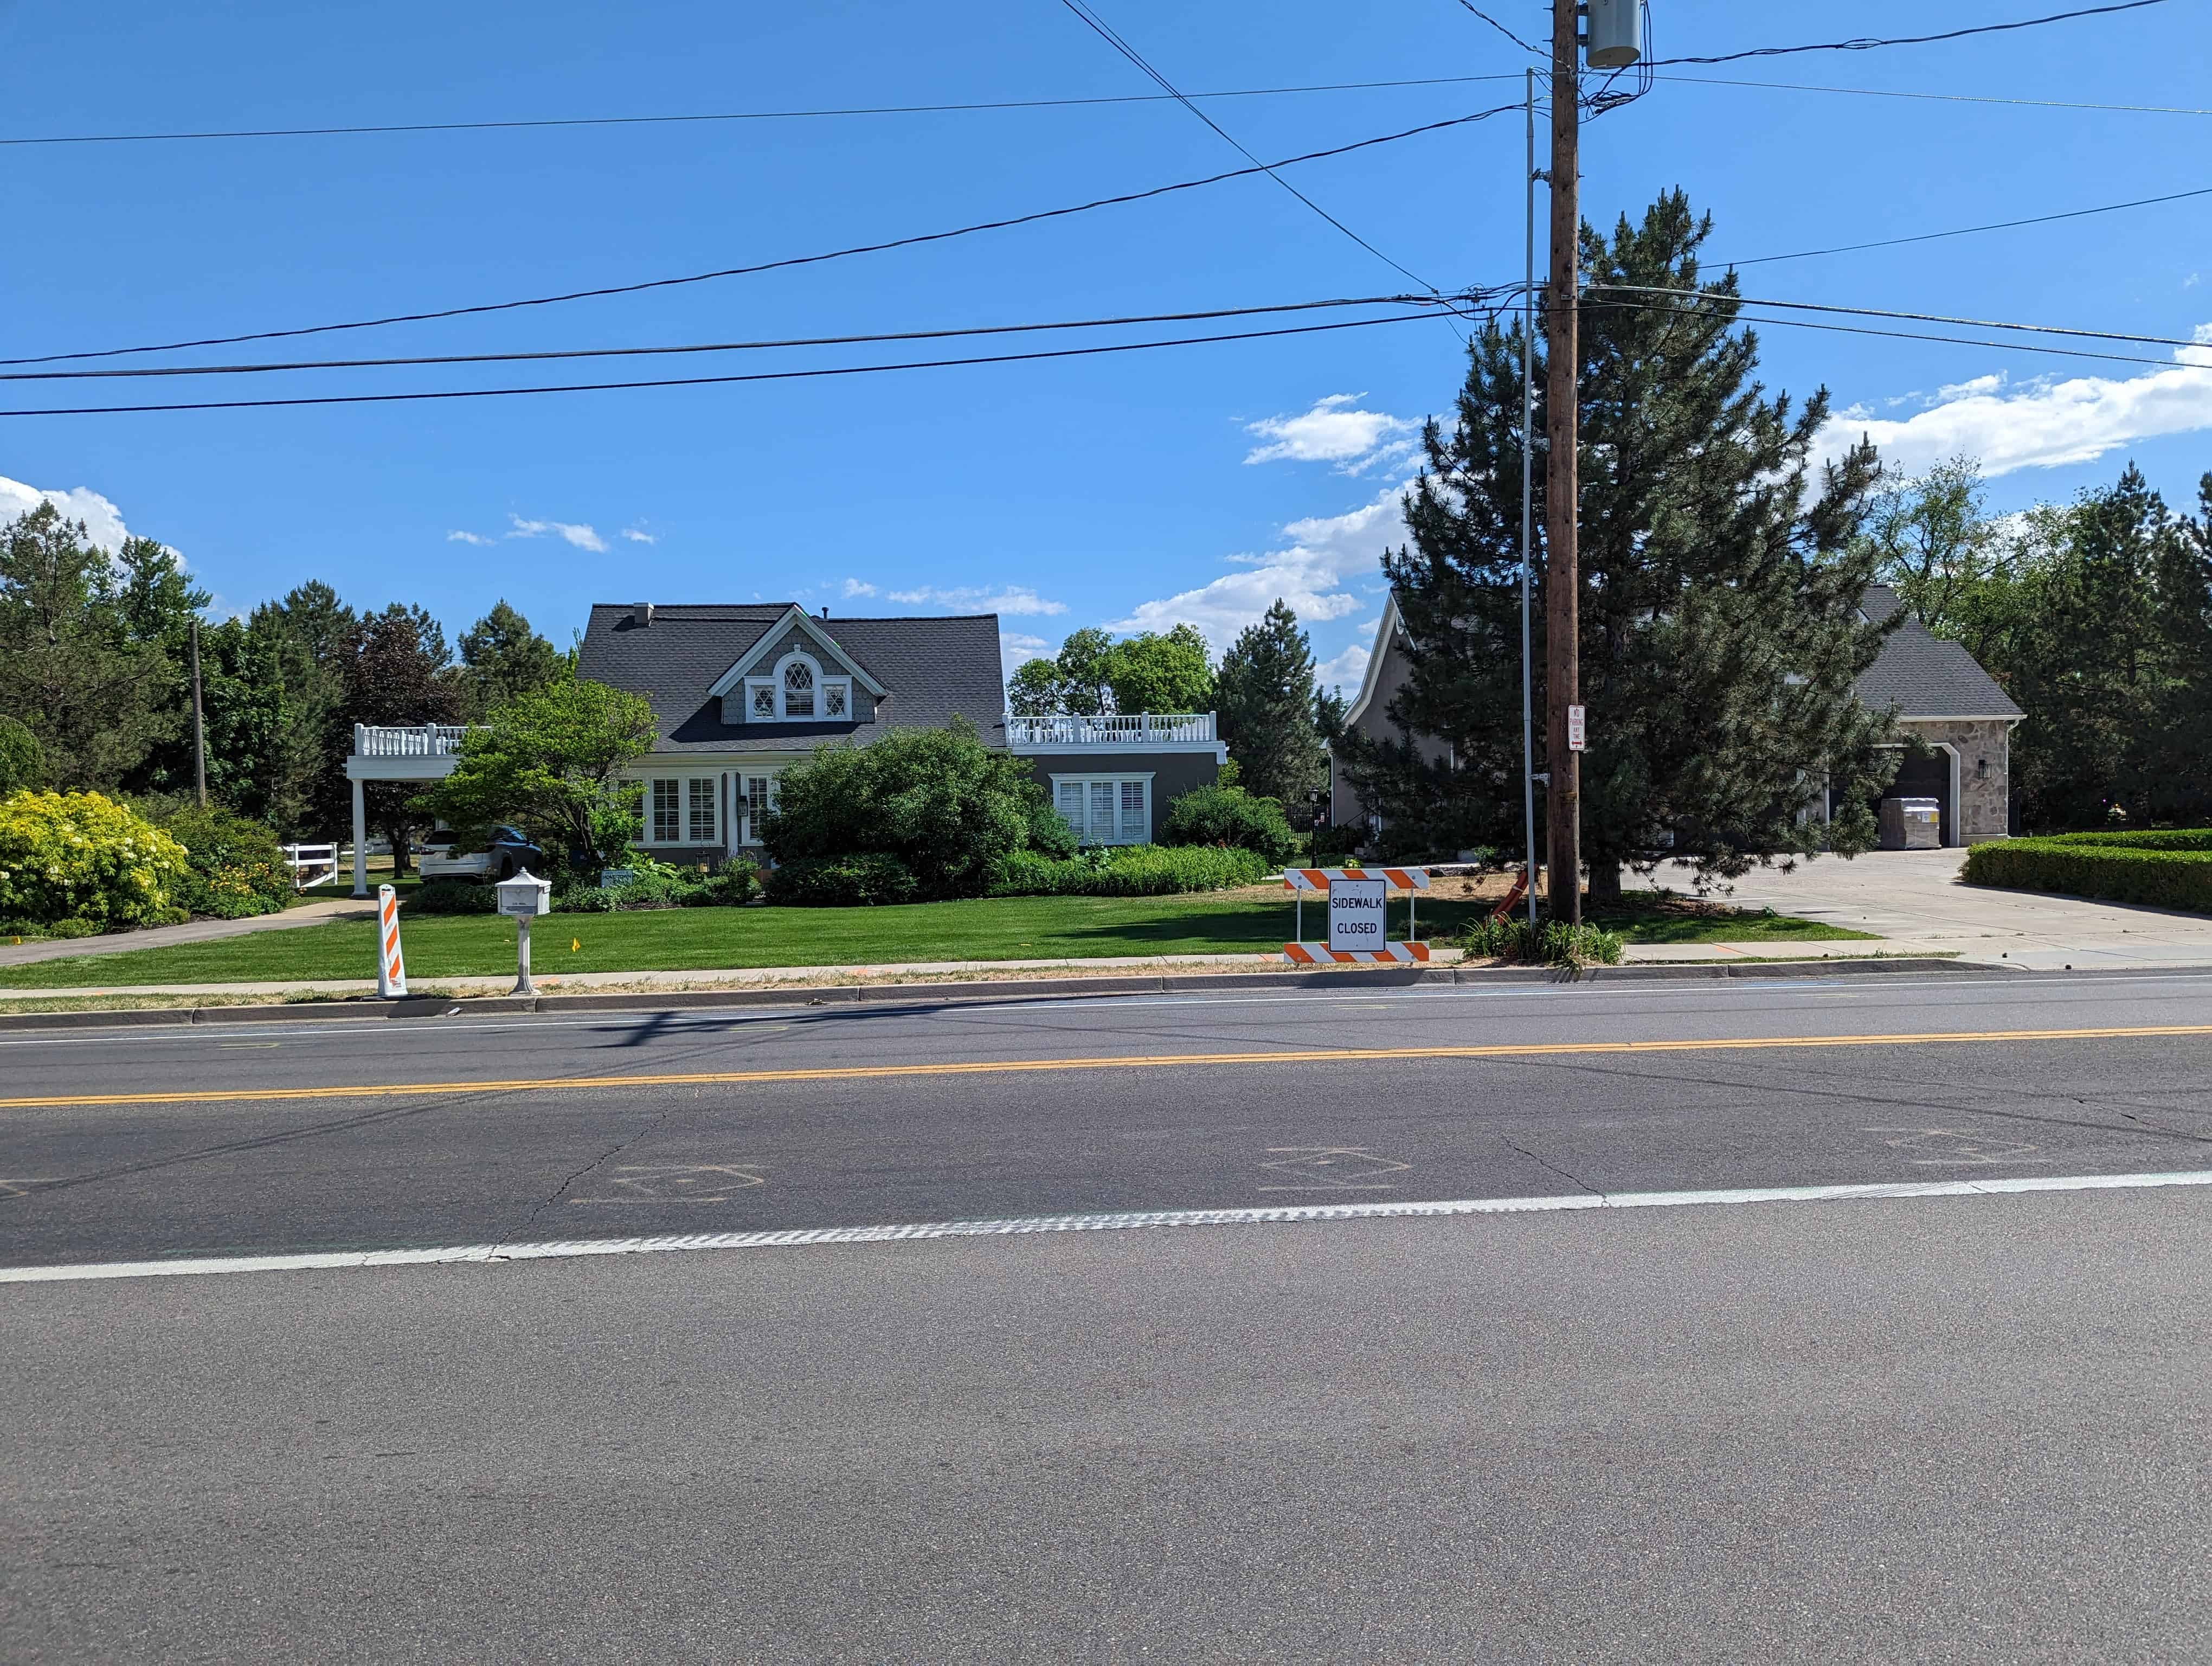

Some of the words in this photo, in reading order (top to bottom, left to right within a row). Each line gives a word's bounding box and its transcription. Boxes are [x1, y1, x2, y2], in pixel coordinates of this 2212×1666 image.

[1573, 709, 1580, 717] NO
[1332, 898, 1382, 909] SIDEWALK
[1337, 922, 1377, 934] CLOSED
